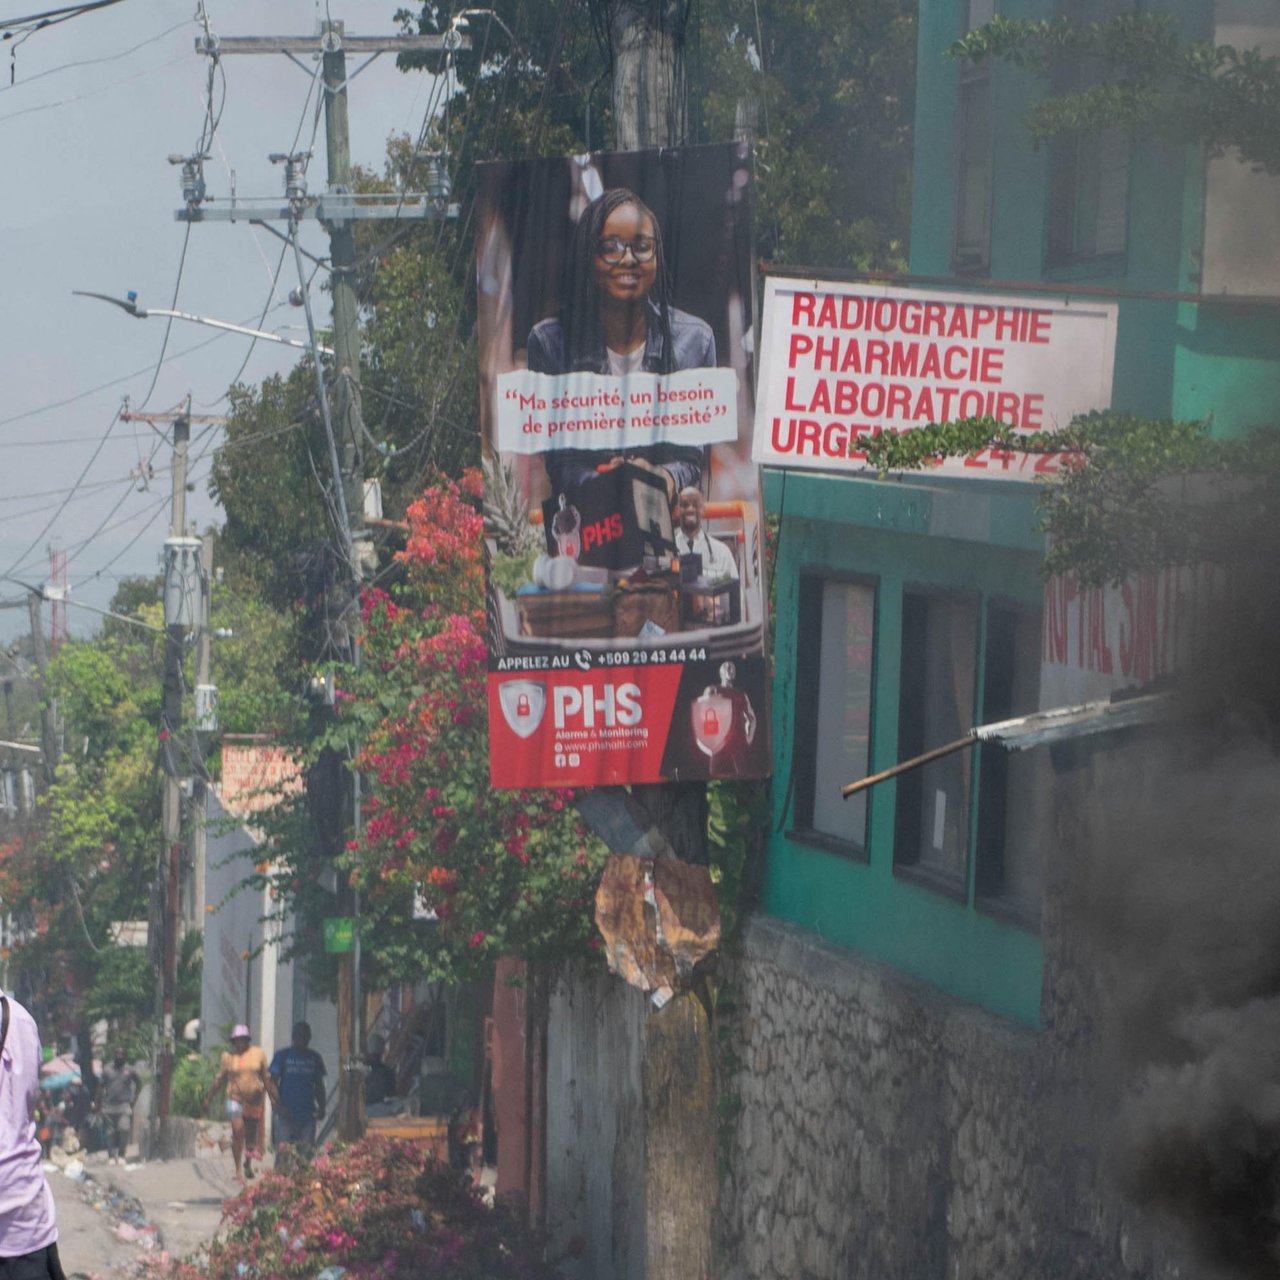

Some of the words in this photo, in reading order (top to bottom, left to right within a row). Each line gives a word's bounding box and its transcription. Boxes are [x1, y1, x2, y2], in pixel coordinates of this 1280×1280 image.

[792, 292, 1053, 344] RADIOGRAPHIE
[788, 334, 1005, 383] PHARMACIE
[630, 391, 652, 405] un
[657, 382, 714, 403] besoin
[785, 376, 1045, 429] LABORATOIRE
[522, 414, 542, 434] de
[548, 413, 626, 438] première
[582, 513, 624, 553] PHS
[498, 656, 549, 670] APPELEZ
[552, 655, 569, 669] AU
[598, 651, 629, 665] +509
[650, 650, 666, 663] 43
[670, 649, 686, 661] 44
[689, 648, 706, 660] 44
[554, 683, 643, 728] PHS
